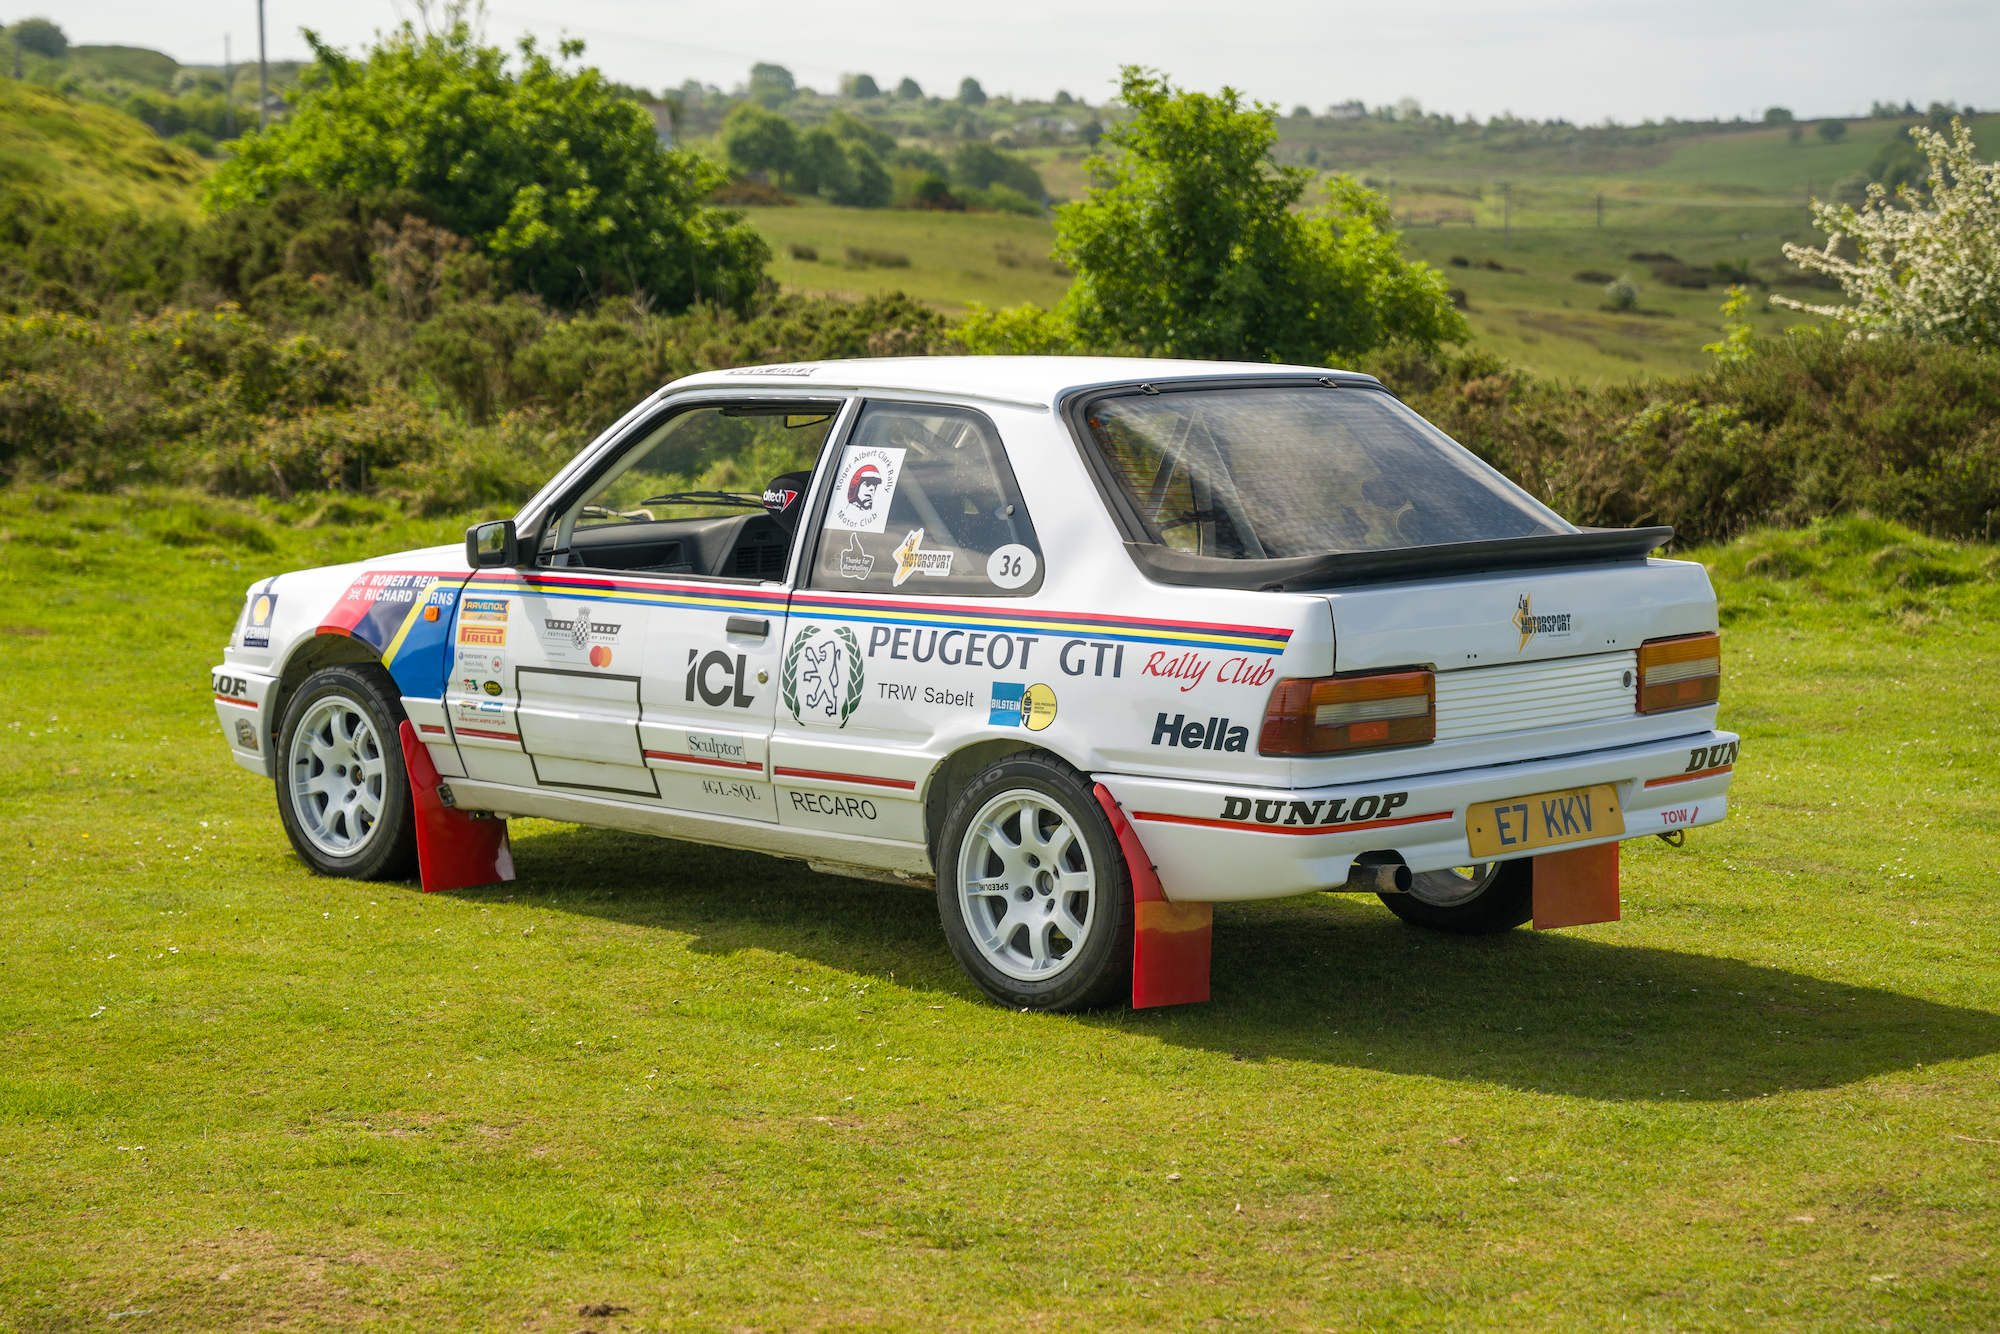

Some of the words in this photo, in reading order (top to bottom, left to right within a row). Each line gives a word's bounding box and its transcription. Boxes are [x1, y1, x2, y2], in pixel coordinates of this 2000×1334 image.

[854, 450, 877, 464] Albert
[878, 451, 893, 469] Clark
[836, 463, 852, 491] Roger
[884, 469, 894, 493] Rally
[837, 510, 857, 528] Motor
[860, 513, 878, 527] Club
[843, 564, 869, 574] Marshalling
[902, 553, 951, 569] MOTORSPORT
[1000, 555, 1021, 577] 36
[370, 574, 413, 587] ROBERT
[412, 576, 439, 588] REID
[364, 589, 412, 602] RICHARD
[416, 591, 454, 605] BURNS
[466, 601, 504, 610] RAVENOL
[245, 626, 270, 640] GEMINI
[1521, 614, 1571, 634] MOTORSPORT
[461, 627, 504, 644] PIRELLI
[868, 626, 1039, 670] PEUGEOT
[1060, 640, 1124, 678] GTI
[1142, 651, 1211, 692] Rally
[1216, 656, 1275, 686] Club
[878, 682, 917, 701] TRW
[924, 687, 974, 707] Sabelt
[992, 699, 1021, 710] BILSTEIN
[1151, 712, 1250, 752] Hella
[688, 736, 742, 757] Sculptor
[1684, 740, 1740, 772] DUN
[702, 780, 760, 802] 4GL-SQL
[790, 791, 877, 820] RECARO
[1220, 792, 1408, 824] DUNLOP
[1494, 803, 1528, 846] E7
[1541, 794, 1592, 839] KKV
[1660, 808, 1687, 824] TOW
